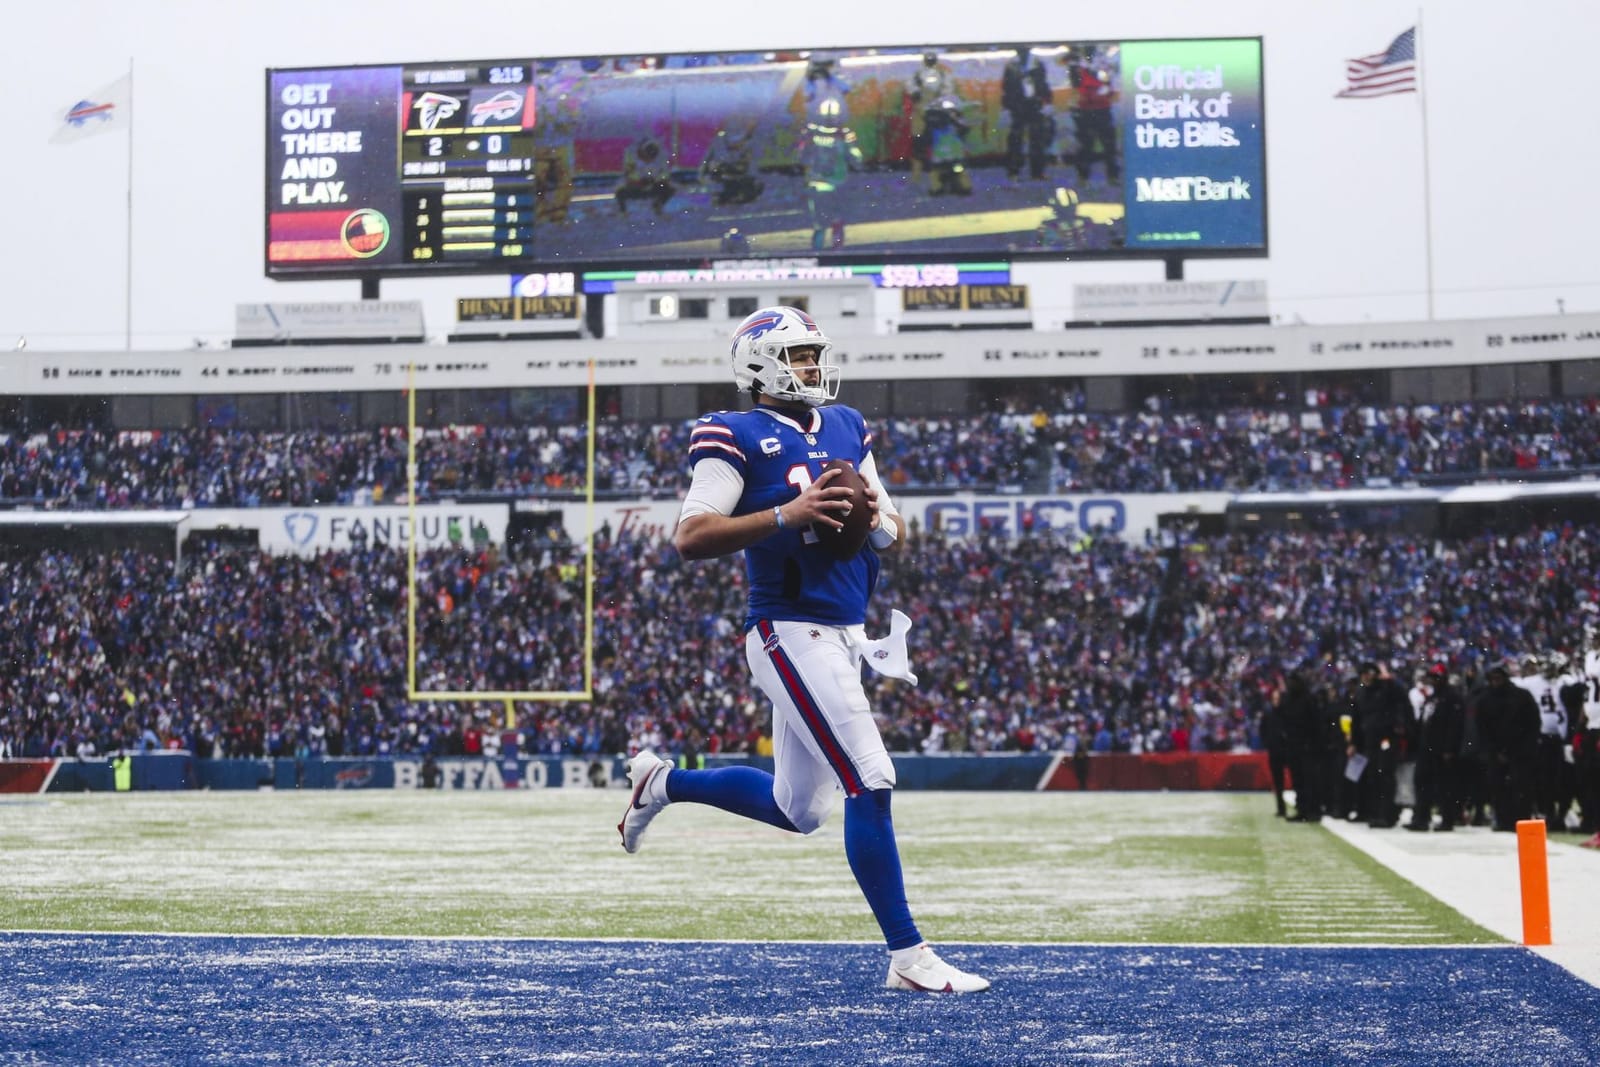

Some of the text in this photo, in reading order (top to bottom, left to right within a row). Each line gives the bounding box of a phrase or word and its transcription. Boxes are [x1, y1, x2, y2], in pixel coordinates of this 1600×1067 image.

[1134, 65, 1224, 91] Official
[281, 83, 331, 105] GET
[1134, 91, 1233, 119] Bank of
[281, 107, 336, 130] OUT
[281, 131, 363, 155] THERE
[487, 135, 502, 154] 0
[1135, 120, 1240, 149] the Bills.
[429, 137, 442, 156] 2
[281, 157, 338, 180] AND
[281, 181, 349, 205] PLAY.
[906, 286, 957, 304] HUNT
[970, 285, 1023, 303] HUNT
[463, 298, 511, 315] HUNT
[524, 297, 572, 314] HUNT
[201, 367, 219, 378] 44
[760, 437, 781, 454] C
[924, 499, 1127, 538] GEICO
[393, 760, 548, 789] BFFAO
